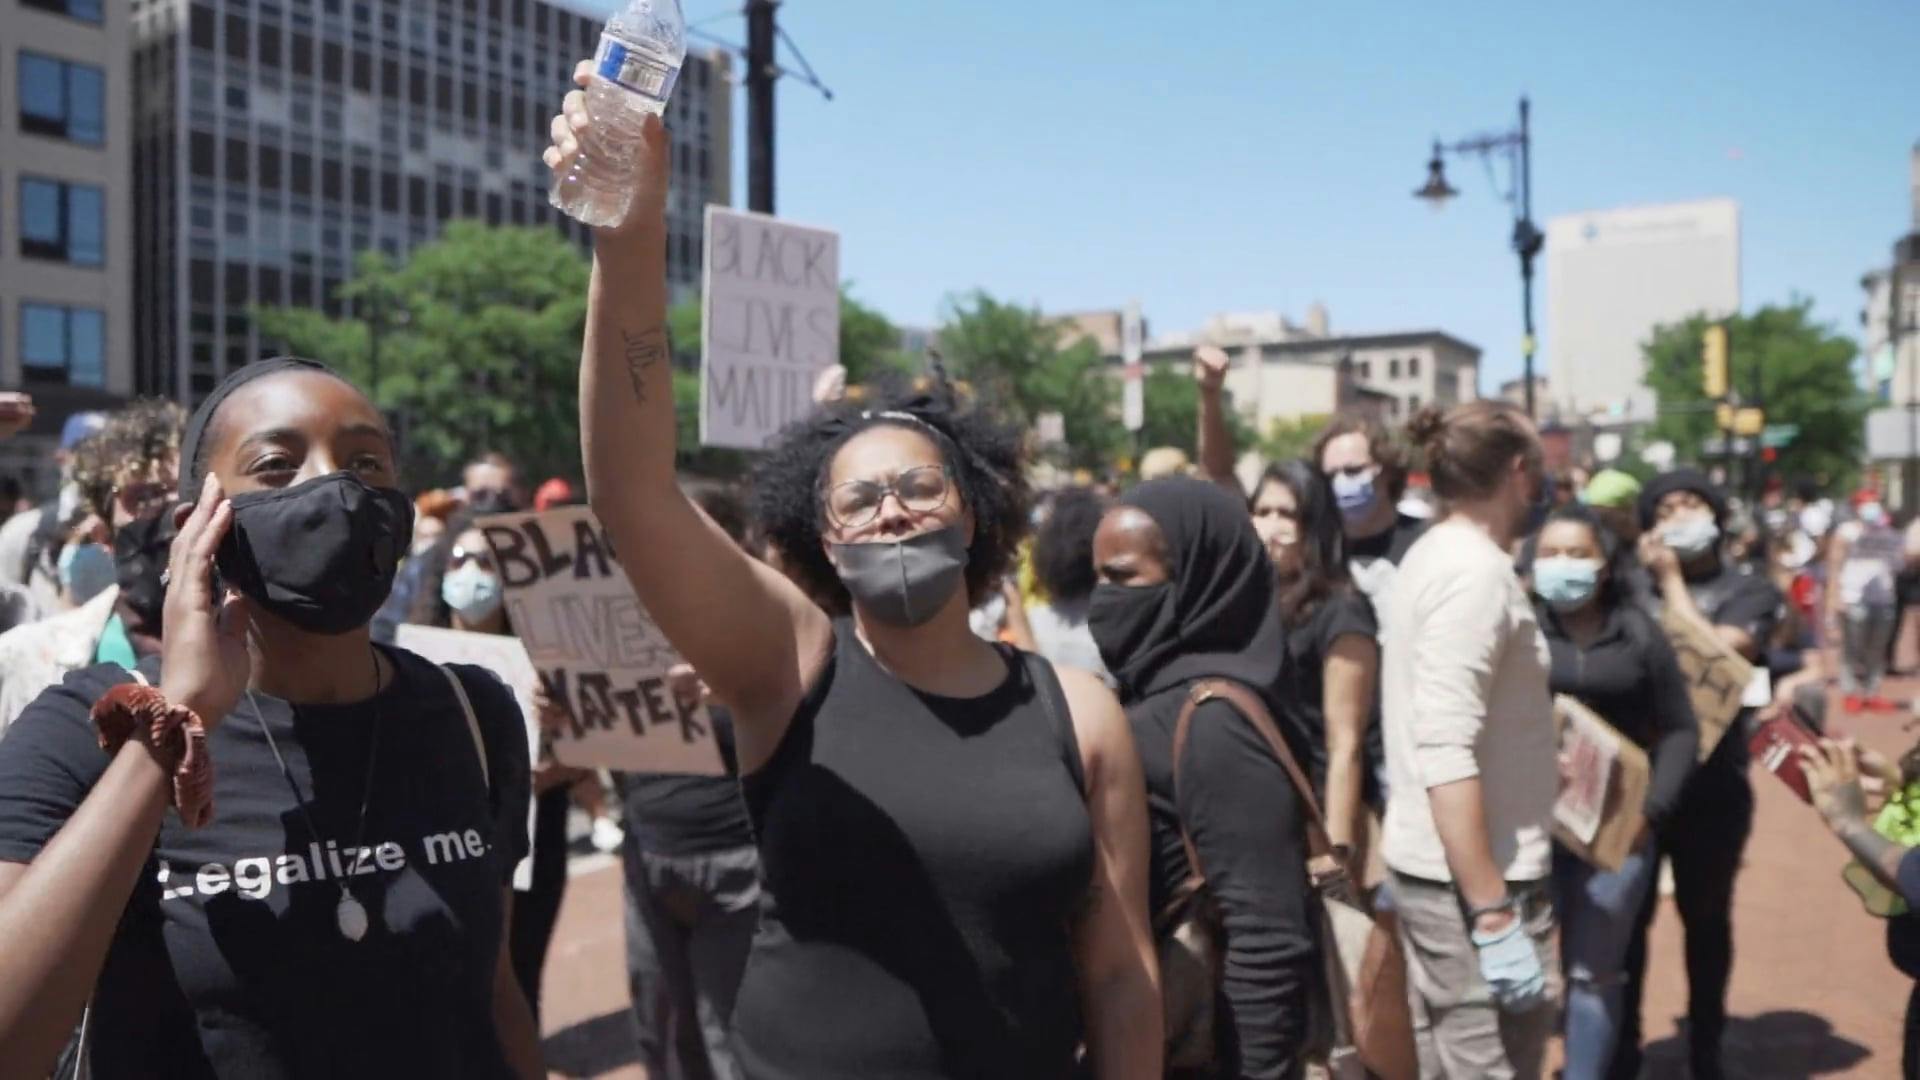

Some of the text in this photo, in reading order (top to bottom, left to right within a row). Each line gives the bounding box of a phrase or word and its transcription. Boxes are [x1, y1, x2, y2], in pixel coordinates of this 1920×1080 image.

[710, 222, 833, 289] BLACK
[482, 517, 617, 588] BLA
[157, 828, 492, 900] Legalize me.
